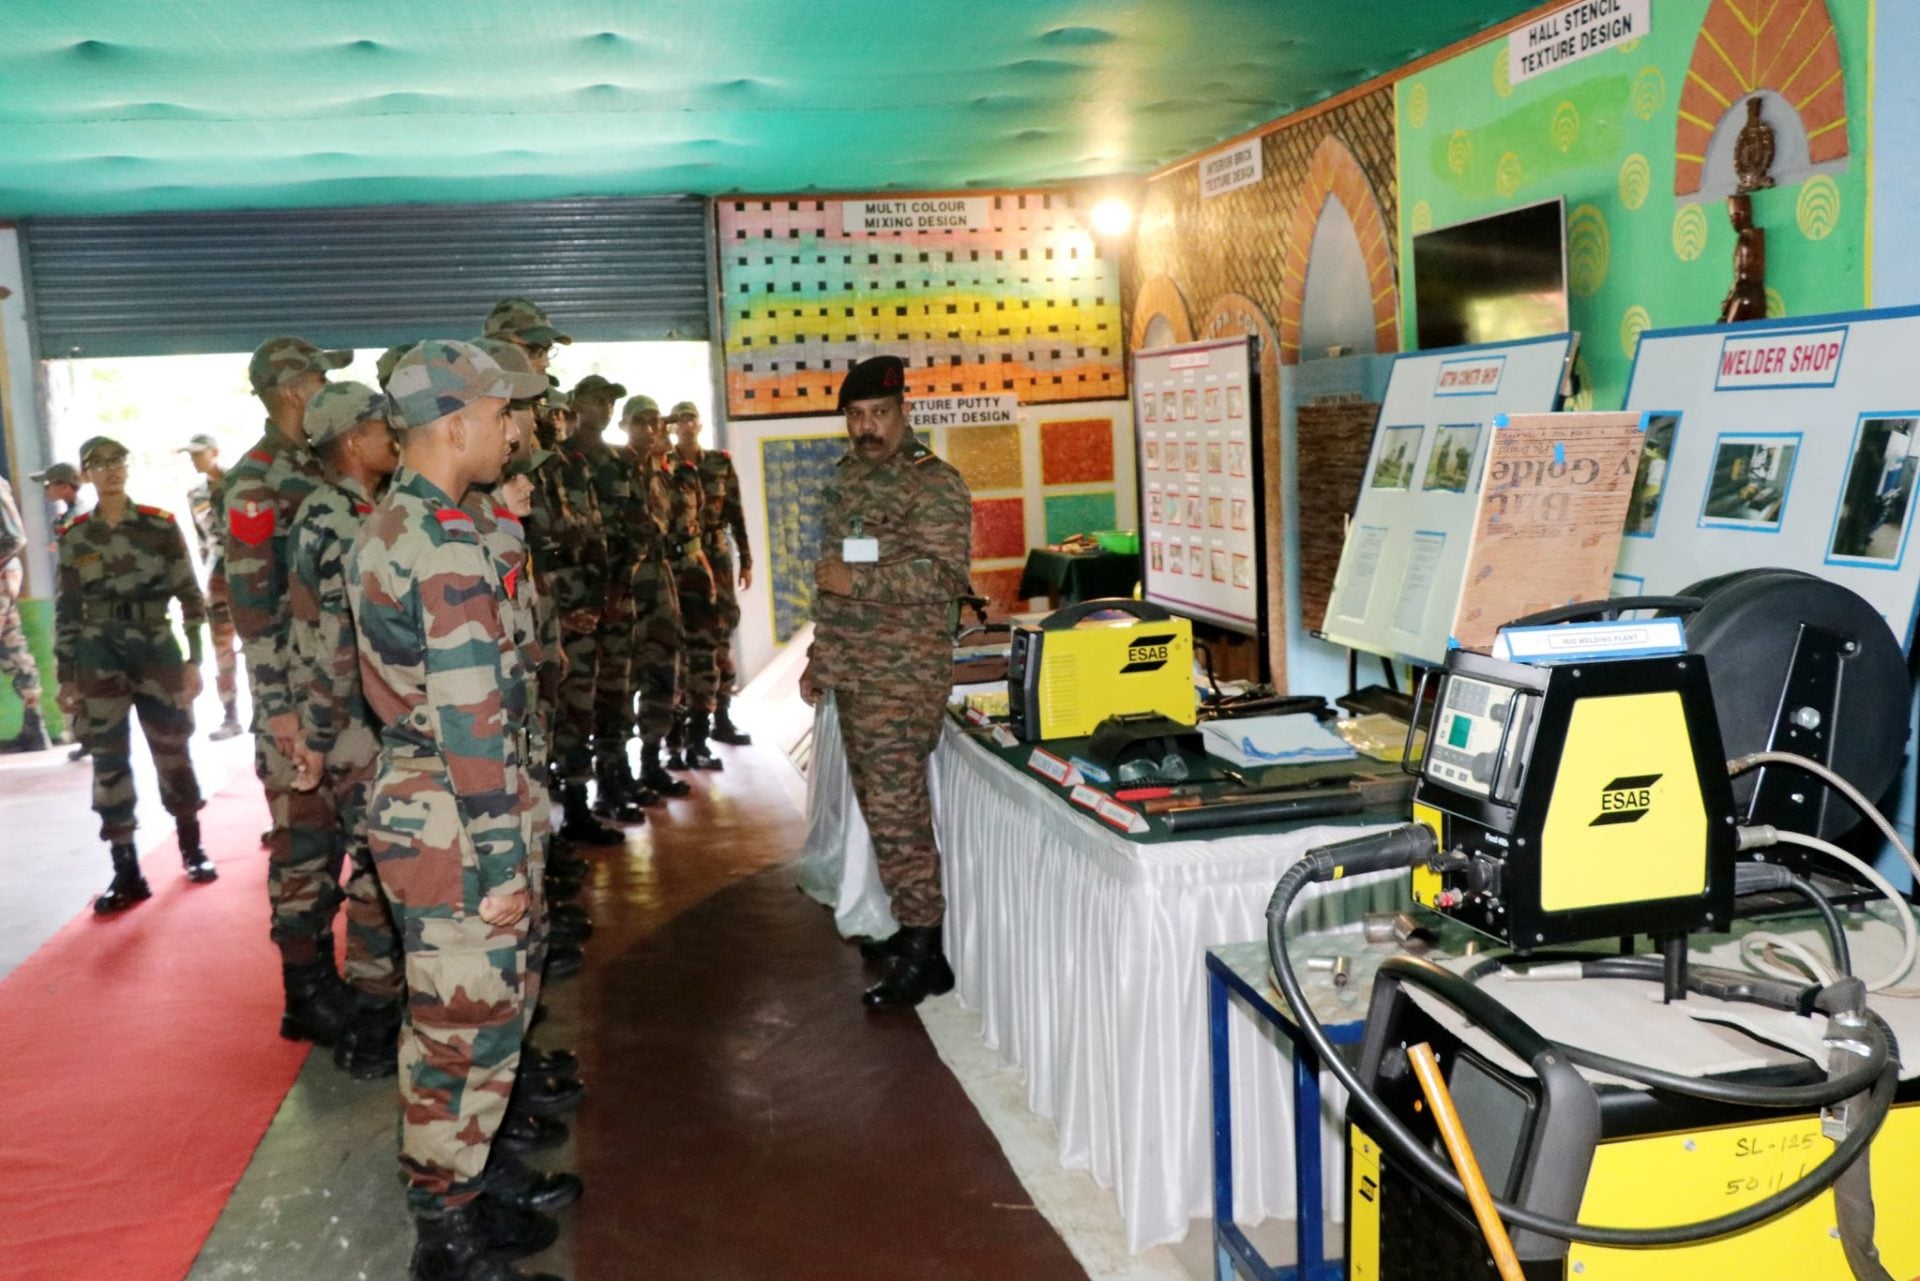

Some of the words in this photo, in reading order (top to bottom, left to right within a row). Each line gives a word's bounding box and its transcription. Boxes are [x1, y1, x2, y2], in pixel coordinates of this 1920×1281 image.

[1529, 18, 1560, 48] HALL
[1564, 0, 1621, 31] STENCIL
[1521, 36, 1576, 75] TEXTURE
[1581, 13, 1632, 51] DESIGN
[865, 202, 907, 214] MULTI
[912, 201, 965, 213] COLOUR
[865, 217, 913, 228] MIXING
[918, 215, 967, 227] DESIGN
[1722, 346, 1787, 375] WELDER
[1790, 342, 1840, 372] SHOP
[957, 397, 1001, 408] PUTTY
[962, 410, 1011, 423] DESIGN
[1128, 646, 1168, 661] ESAB
[1602, 789, 1650, 811] ESAB
